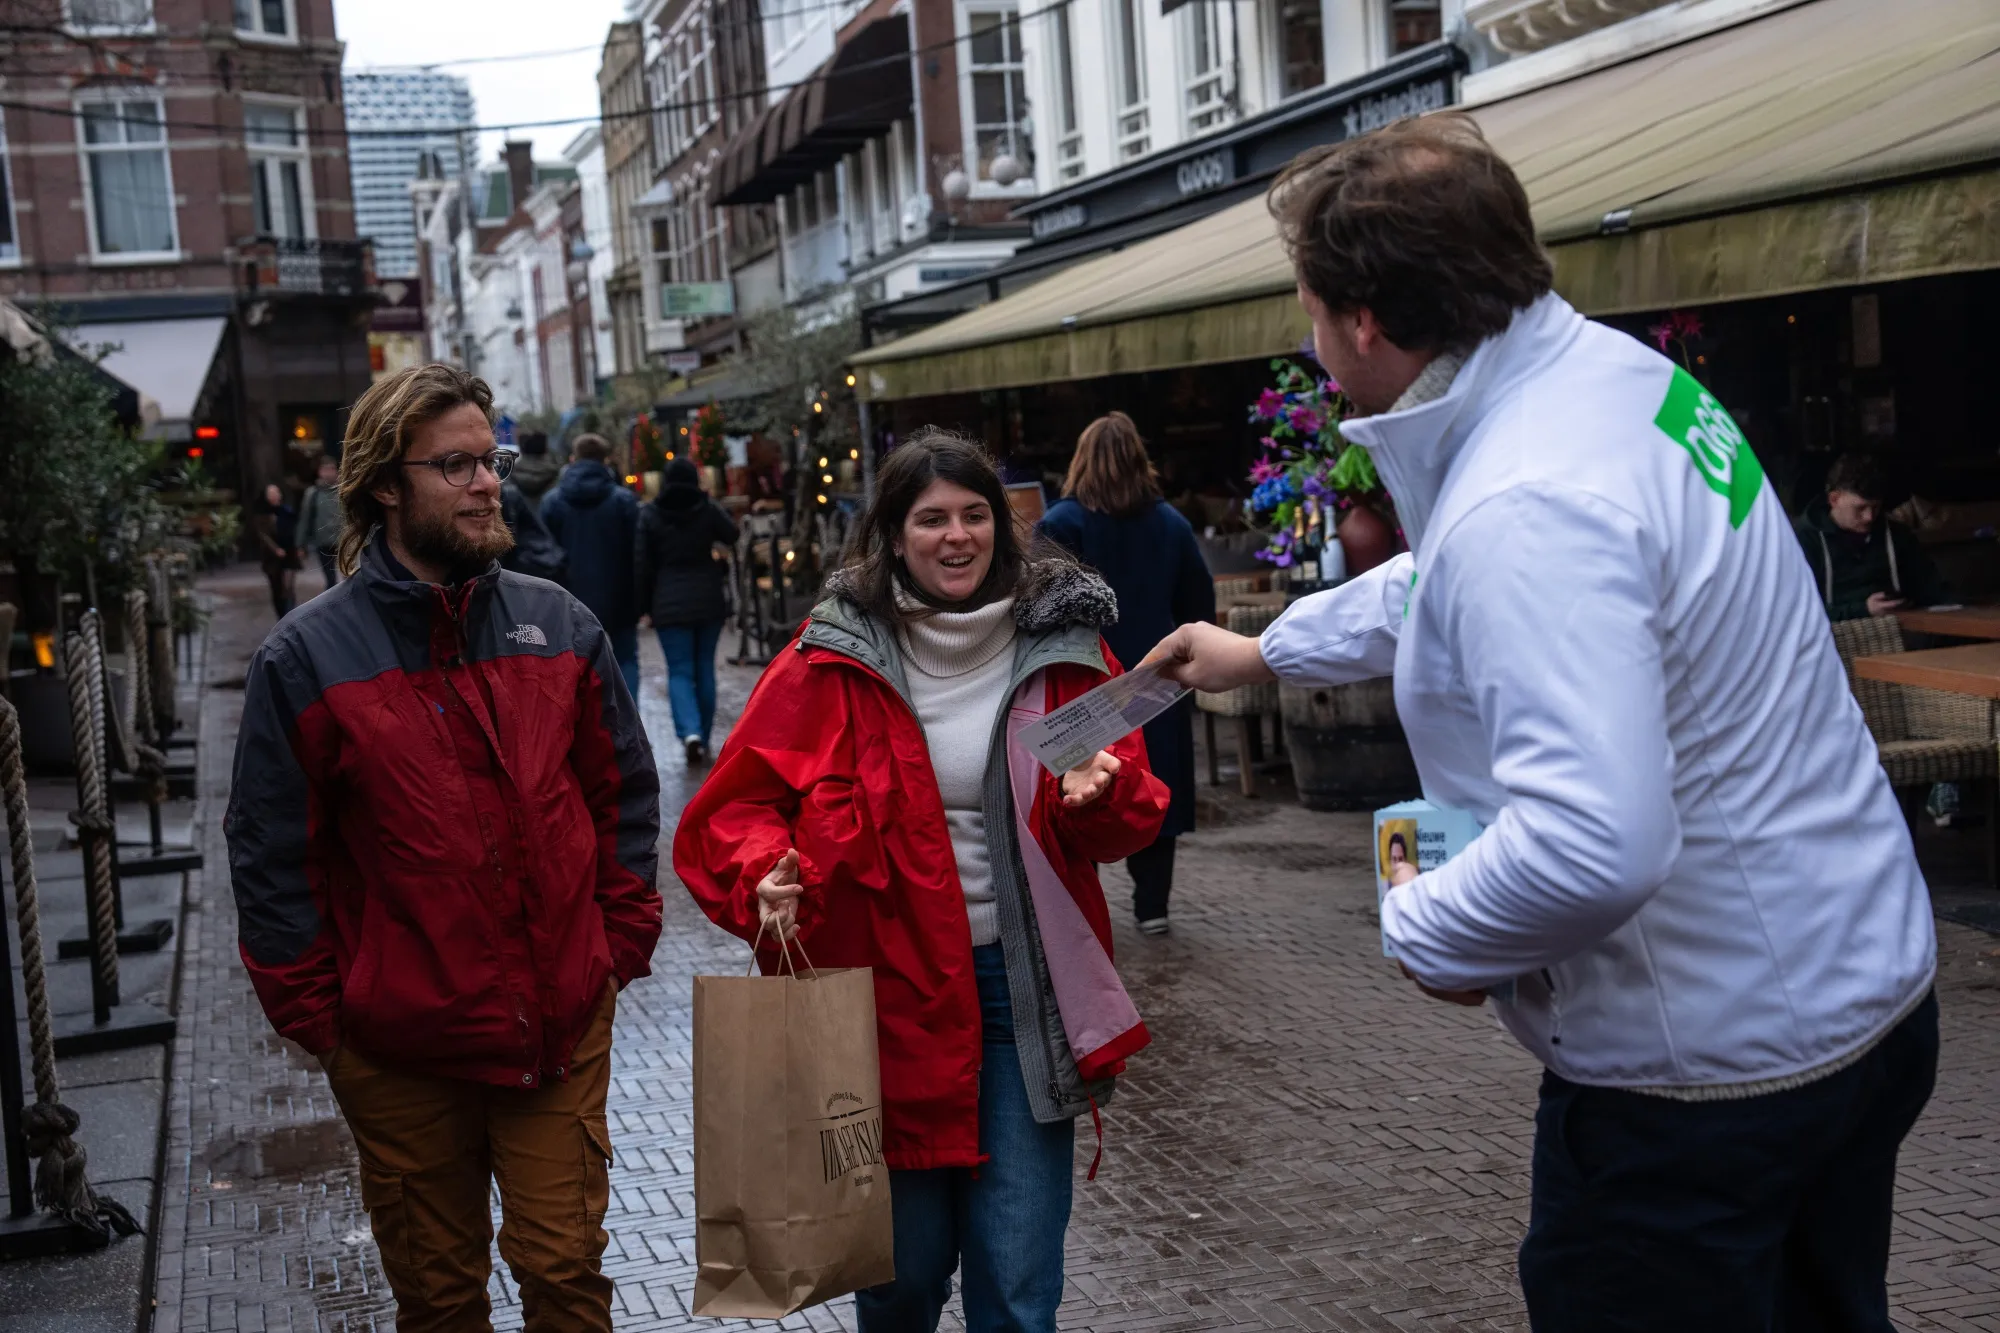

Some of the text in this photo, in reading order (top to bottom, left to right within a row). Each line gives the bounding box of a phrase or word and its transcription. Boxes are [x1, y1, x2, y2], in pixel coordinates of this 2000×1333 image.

[1686, 392, 1742, 485] D66
[506, 631, 533, 639] NORTH
[1044, 701, 1085, 726] Nieuwe
[1048, 705, 1087, 730] energie
[1067, 709, 1091, 724] voor
[1415, 828, 1445, 842] Nieuwe
[1416, 845, 1446, 864] energie
